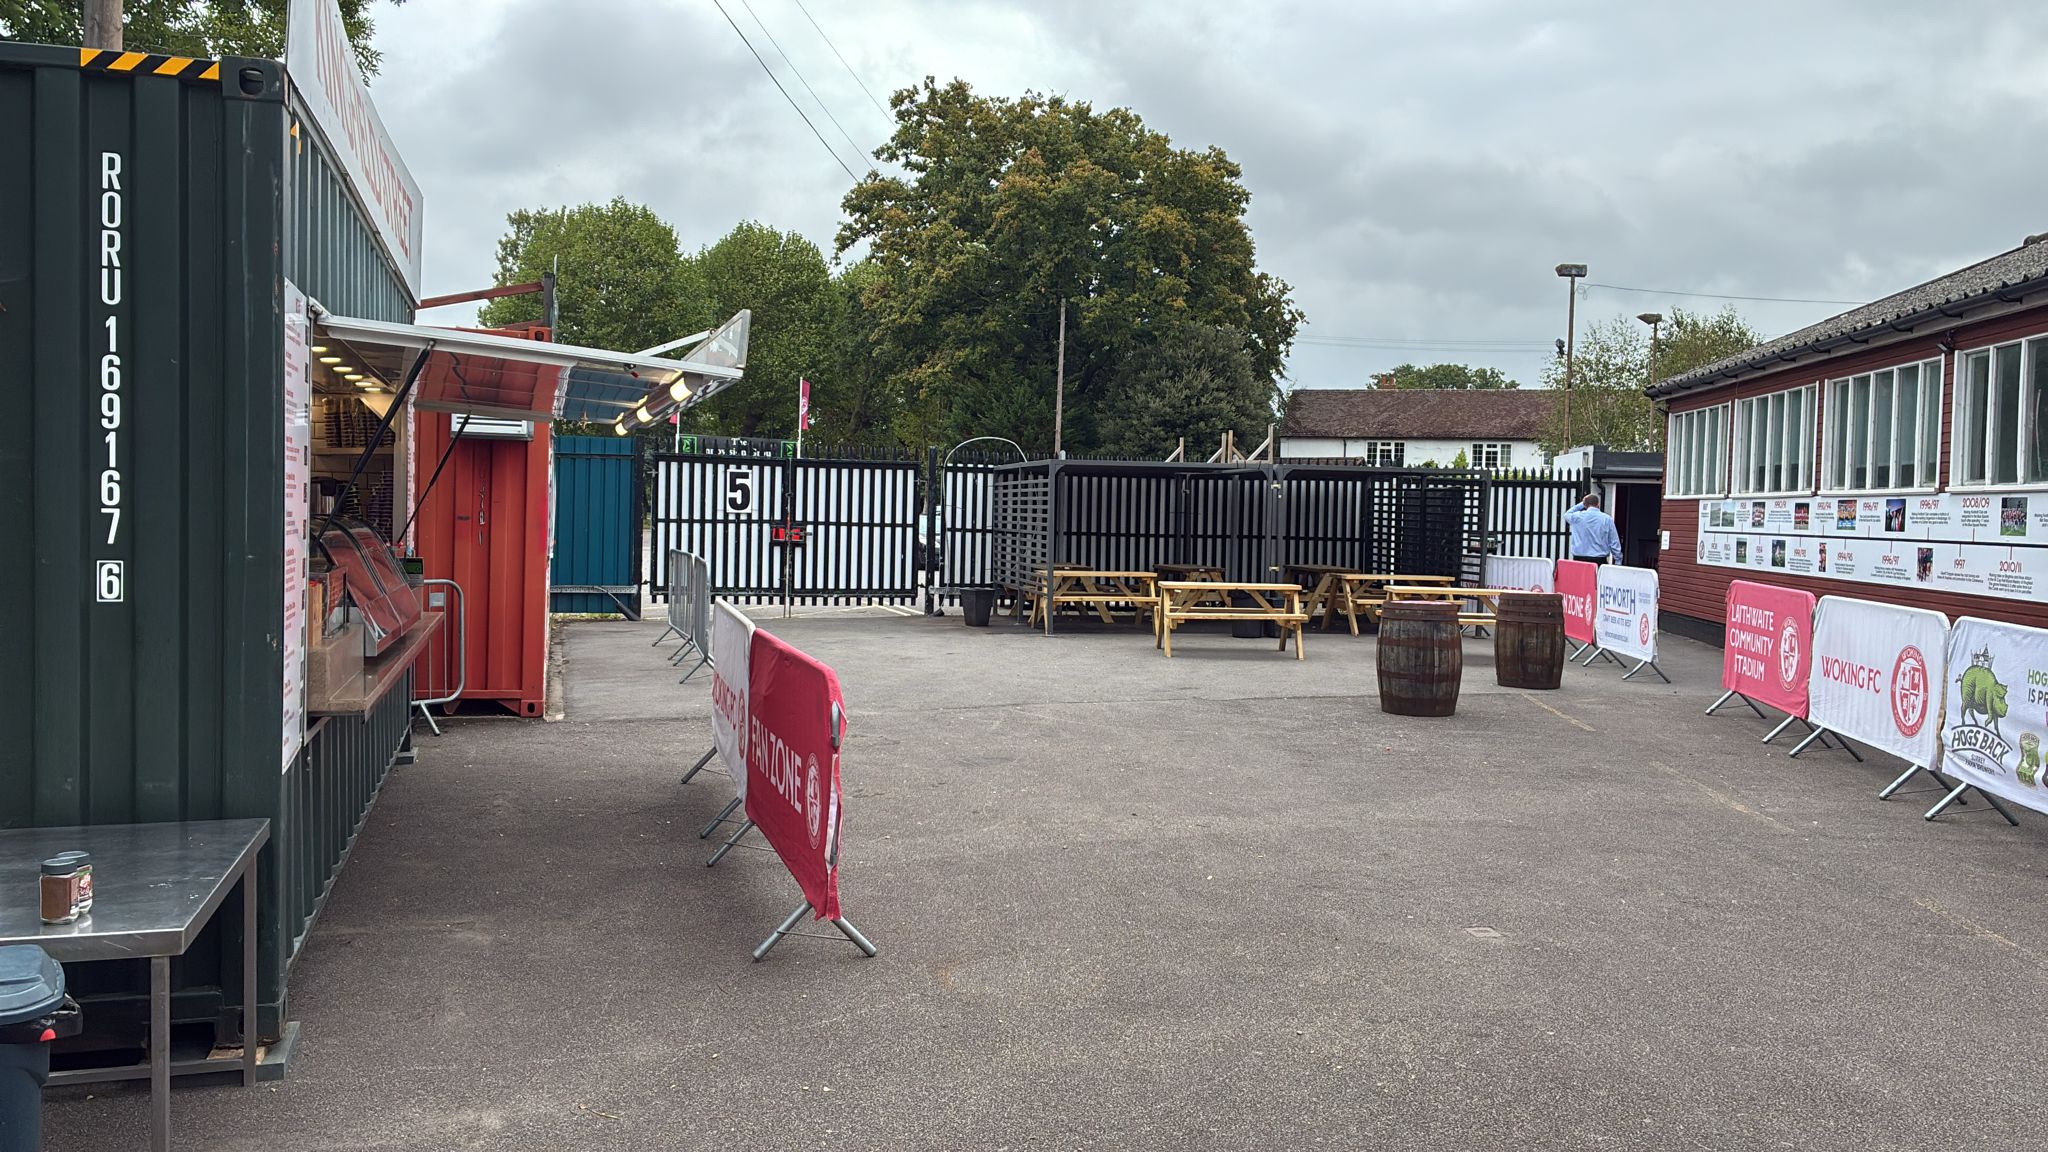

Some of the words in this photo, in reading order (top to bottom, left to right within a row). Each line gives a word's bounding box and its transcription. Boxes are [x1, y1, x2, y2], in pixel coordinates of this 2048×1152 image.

[379, 139, 413, 265] STREET
[101, 151, 122, 306] RORU
[100, 315, 121, 545] 169167
[728, 471, 751, 511] 5
[1919, 499, 1940, 510] 1996/97
[1962, 497, 1990, 509] 2008/09
[1953, 559, 1966, 570] 1997
[1999, 560, 2023, 573] 2010/11
[100, 562, 121, 600] 6
[1567, 594, 1584, 618] ZONE
[1599, 584, 1636, 616] HEPWORTH
[1731, 603, 1775, 632] LAITHWAITE
[1729, 627, 1775, 658] COMMUNITY
[1821, 655, 1866, 689] WOKING
[1866, 667, 1882, 694] FC
[2027, 687, 2036, 703] IS
[1951, 729, 1981, 749] HOGS
[1979, 732, 2010, 766] BACK
[751, 714, 769, 780] FAN
[769, 731, 803, 816] ZONE
